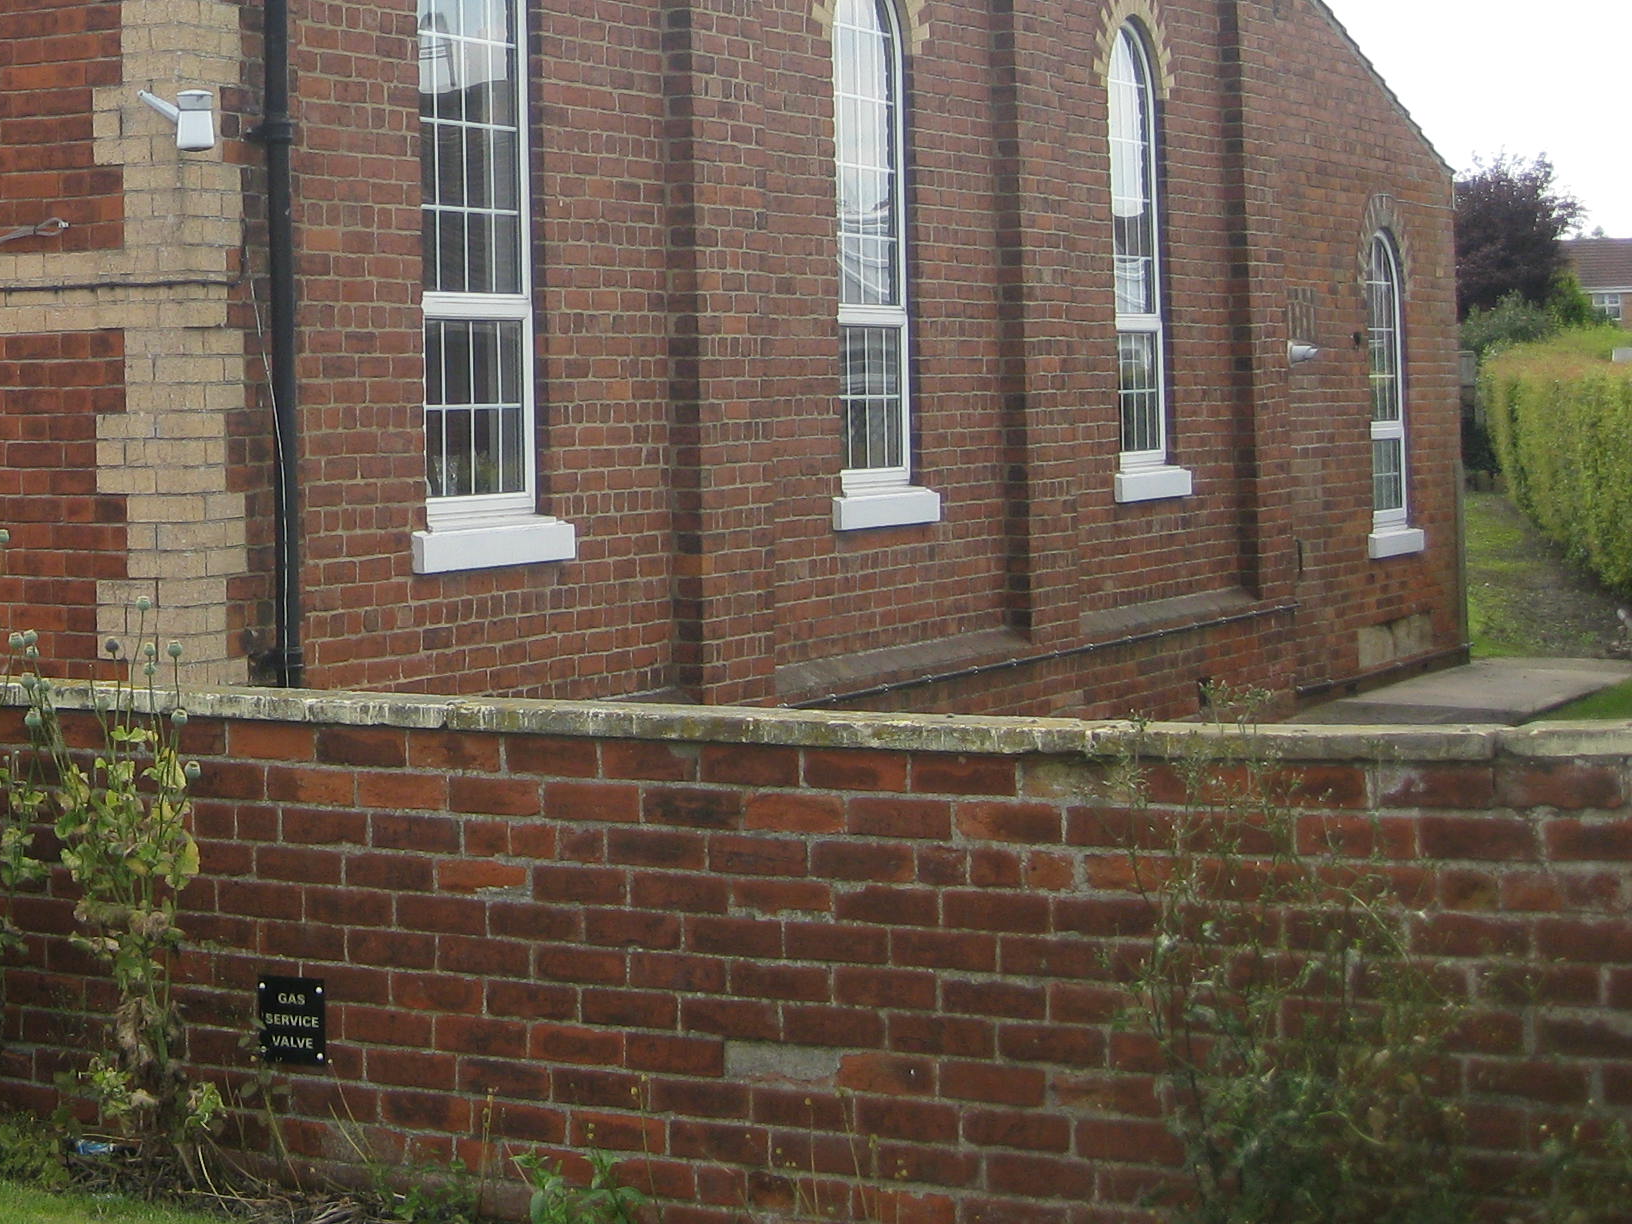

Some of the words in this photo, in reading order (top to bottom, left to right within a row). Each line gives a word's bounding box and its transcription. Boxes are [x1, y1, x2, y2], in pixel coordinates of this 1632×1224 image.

[278, 993, 305, 1005] GAS
[265, 1013, 319, 1028] SERVICE
[272, 1035, 313, 1049] VALVE
